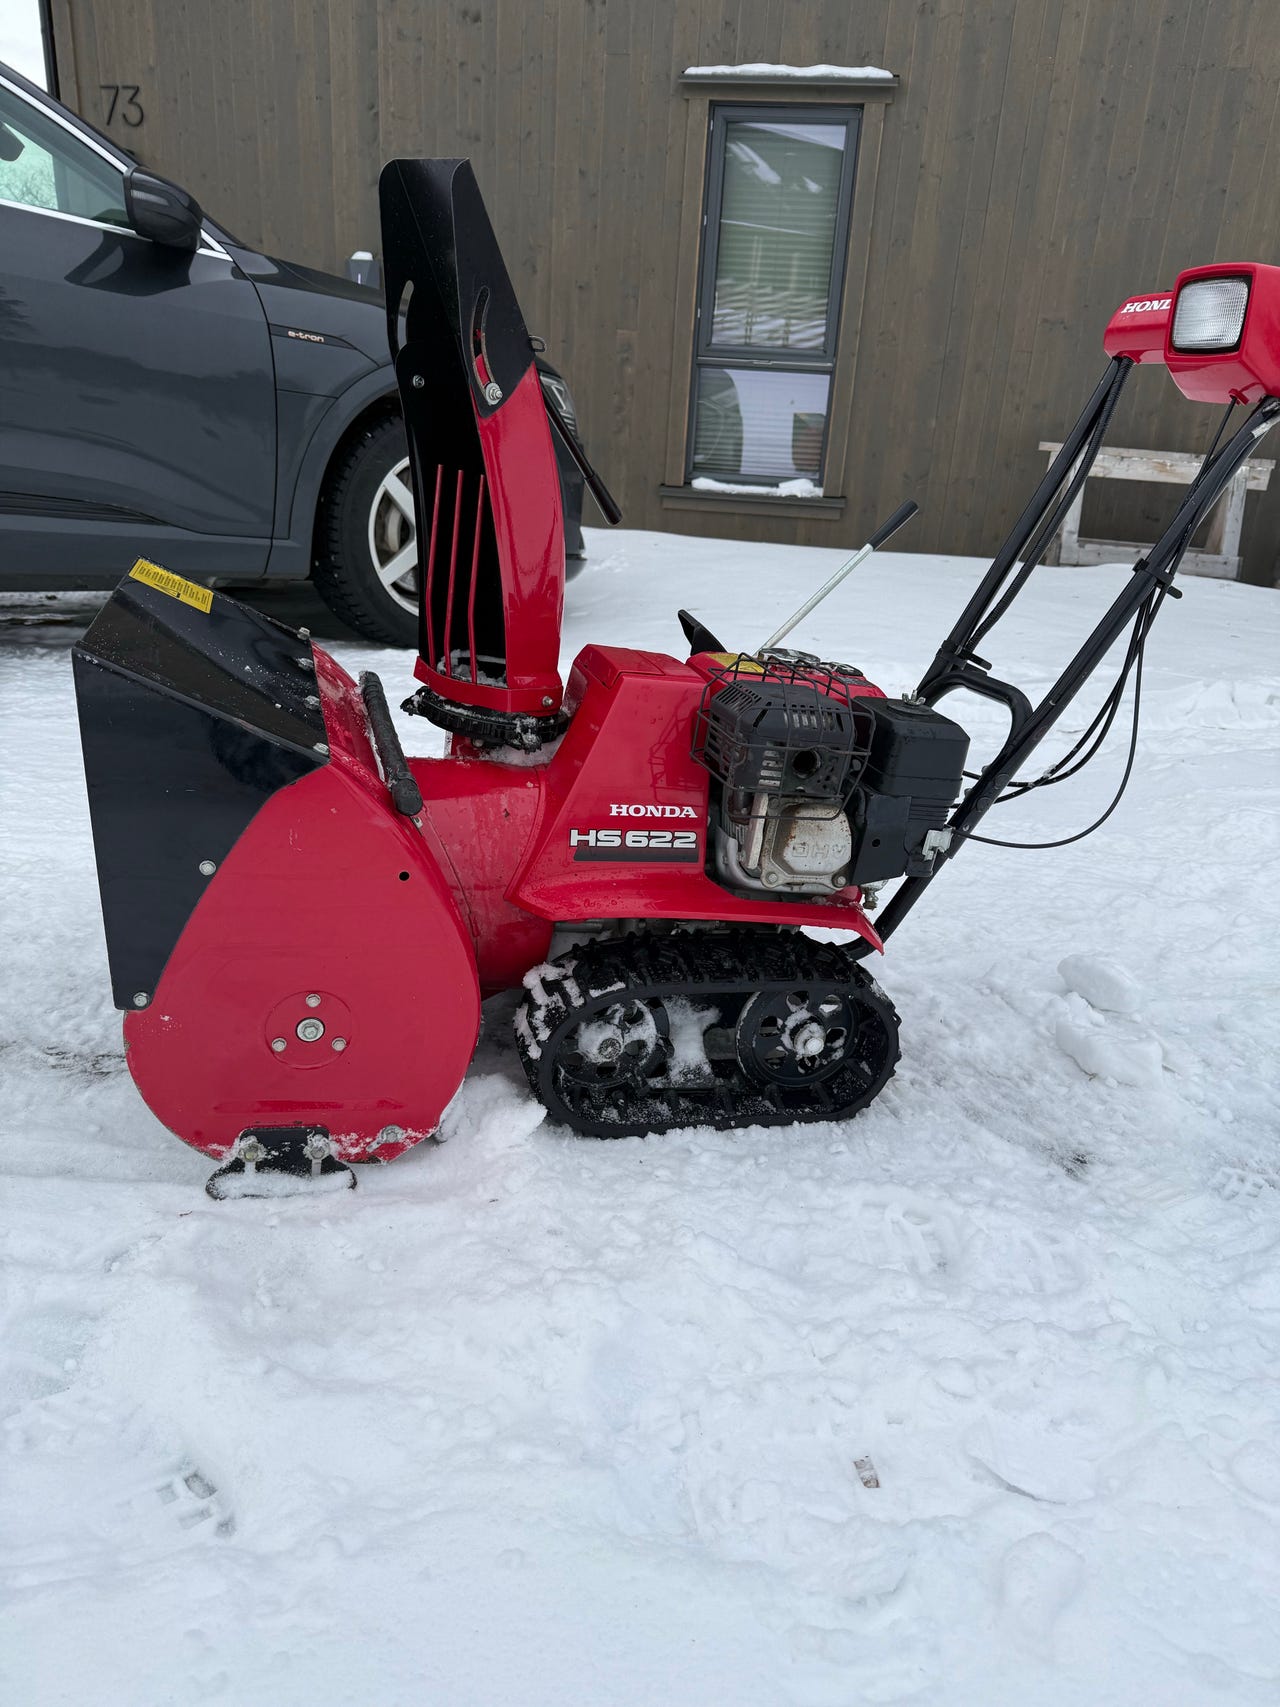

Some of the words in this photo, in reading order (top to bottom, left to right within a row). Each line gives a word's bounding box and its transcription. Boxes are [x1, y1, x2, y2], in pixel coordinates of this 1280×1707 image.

[99, 85, 144, 127] 73
[287, 330, 325, 343] e-tron
[609, 804, 698, 818] HONDA
